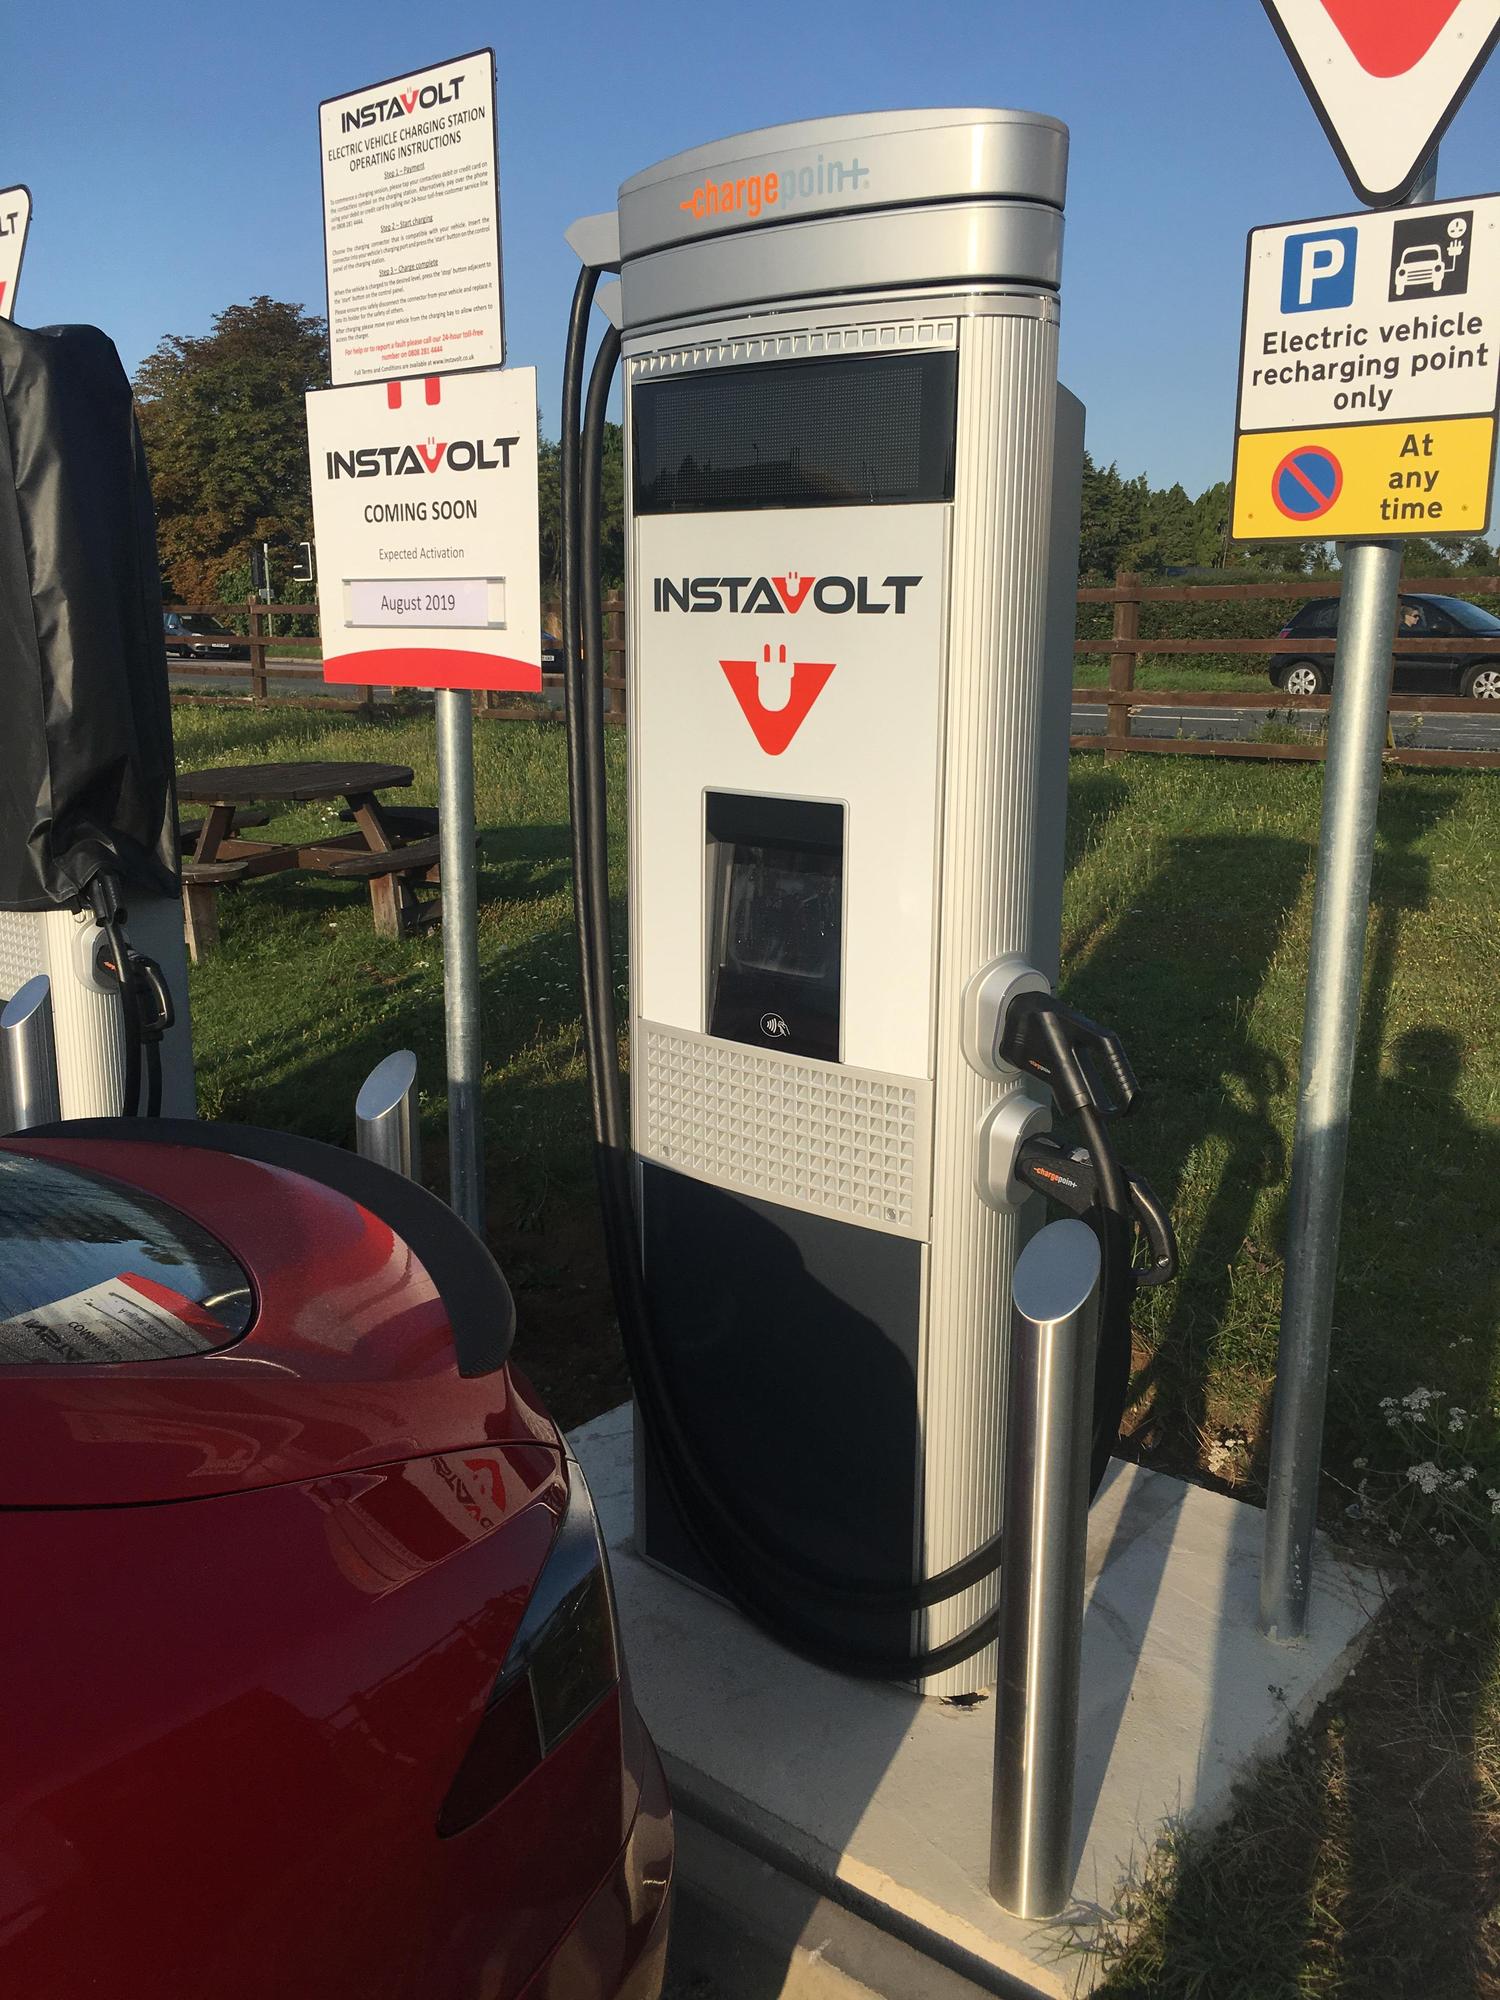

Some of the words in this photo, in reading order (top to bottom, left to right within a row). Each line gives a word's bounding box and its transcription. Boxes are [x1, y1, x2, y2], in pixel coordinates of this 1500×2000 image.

[342, 75, 465, 133] INSTAVOLT
[328, 141, 363, 161] ELECTRIC
[364, 131, 397, 152] VEHICLE
[399, 117, 445, 141] CHARGING
[448, 106, 485, 128] STATION
[349, 148, 395, 172] OPERATING
[398, 130, 461, 159] INSTRUCTIONS
[1298, 239, 1345, 305] P
[1263, 324, 1368, 355] Electric
[1379, 312, 1483, 344] vehicle
[1252, 355, 1400, 386] recharging
[1411, 343, 1489, 377] point
[1333, 385, 1393, 411] only
[326, 437, 520, 480] INSTAVOLT
[1400, 433, 1433, 458] At
[1388, 469, 1439, 493] any
[364, 502, 427, 523] COMING
[432, 500, 477, 521] SOON
[1380, 498, 1443, 521] time
[379, 547, 417, 562] Expected
[419, 546, 464, 560] Activation
[381, 594, 422, 614] August
[425, 594, 455, 611] 2019
[653, 574, 923, 615] INSTAVOLT
